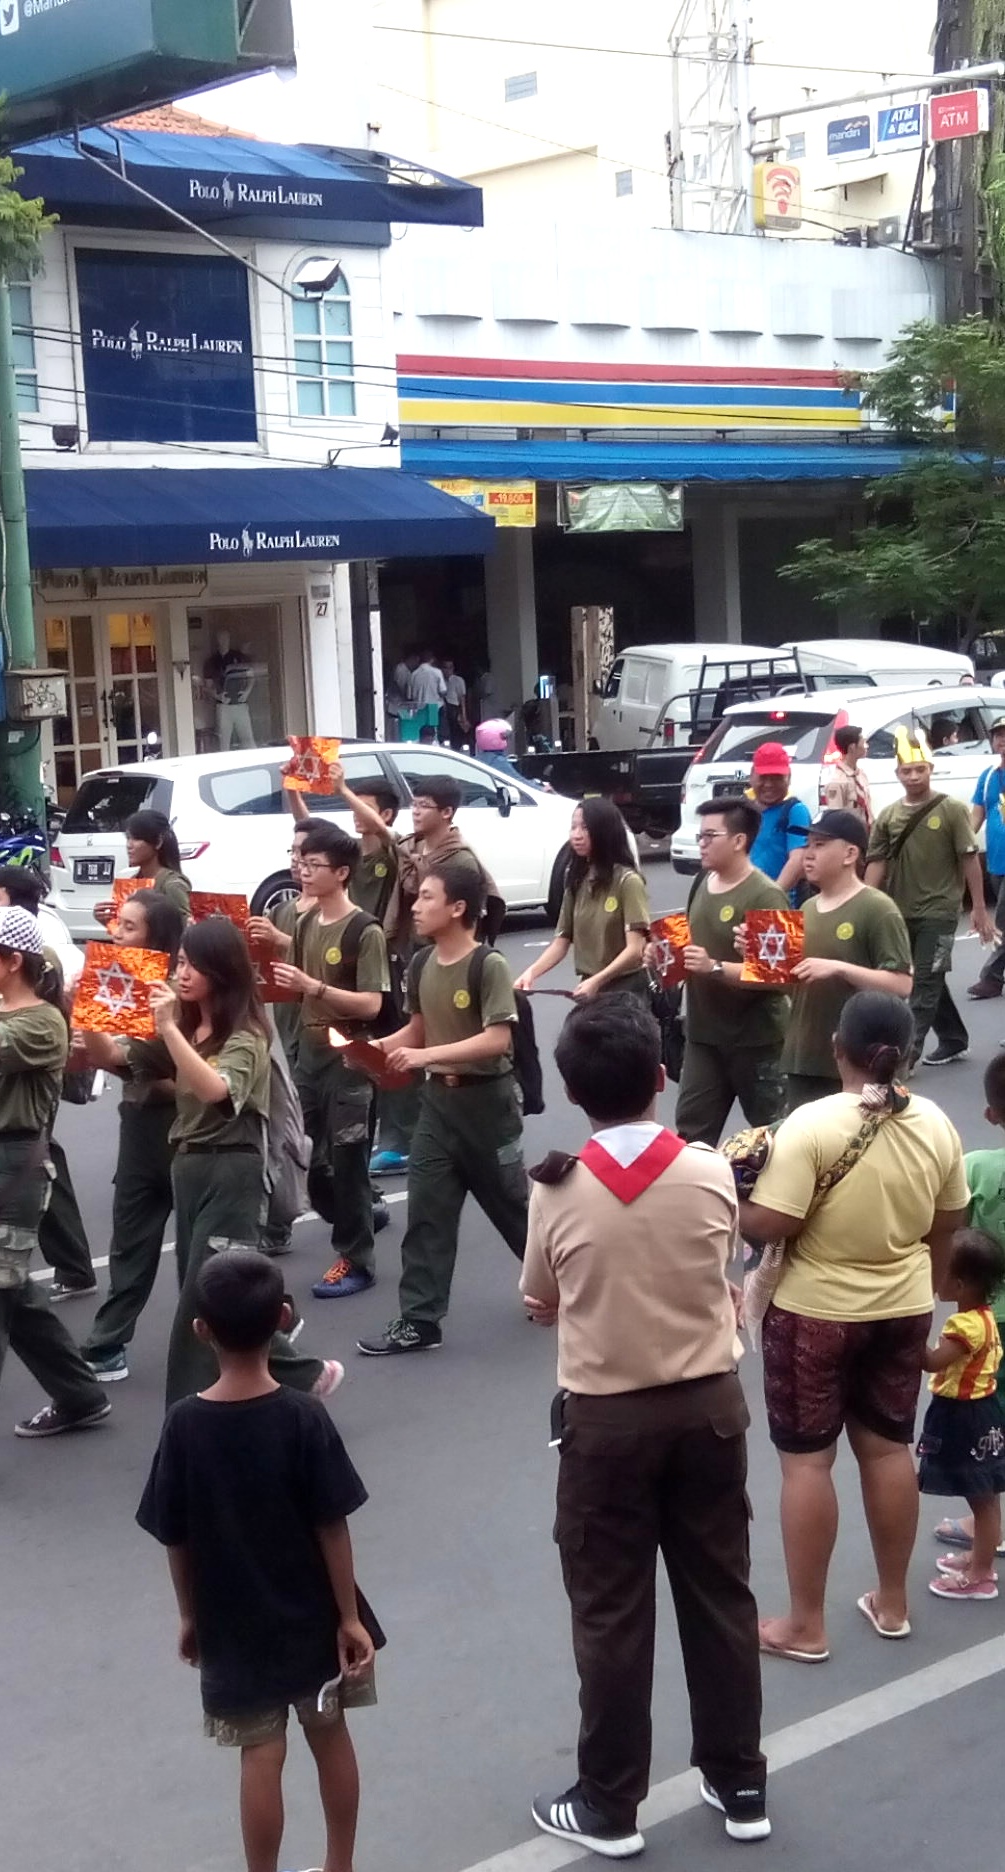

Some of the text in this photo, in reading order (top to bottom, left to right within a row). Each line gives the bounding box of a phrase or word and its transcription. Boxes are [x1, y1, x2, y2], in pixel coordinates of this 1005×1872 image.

[891, 106, 915, 123] ATM
[939, 111, 969, 128] ATM
[897, 120, 918, 135] BCA
[316, 602, 328, 617] 27
